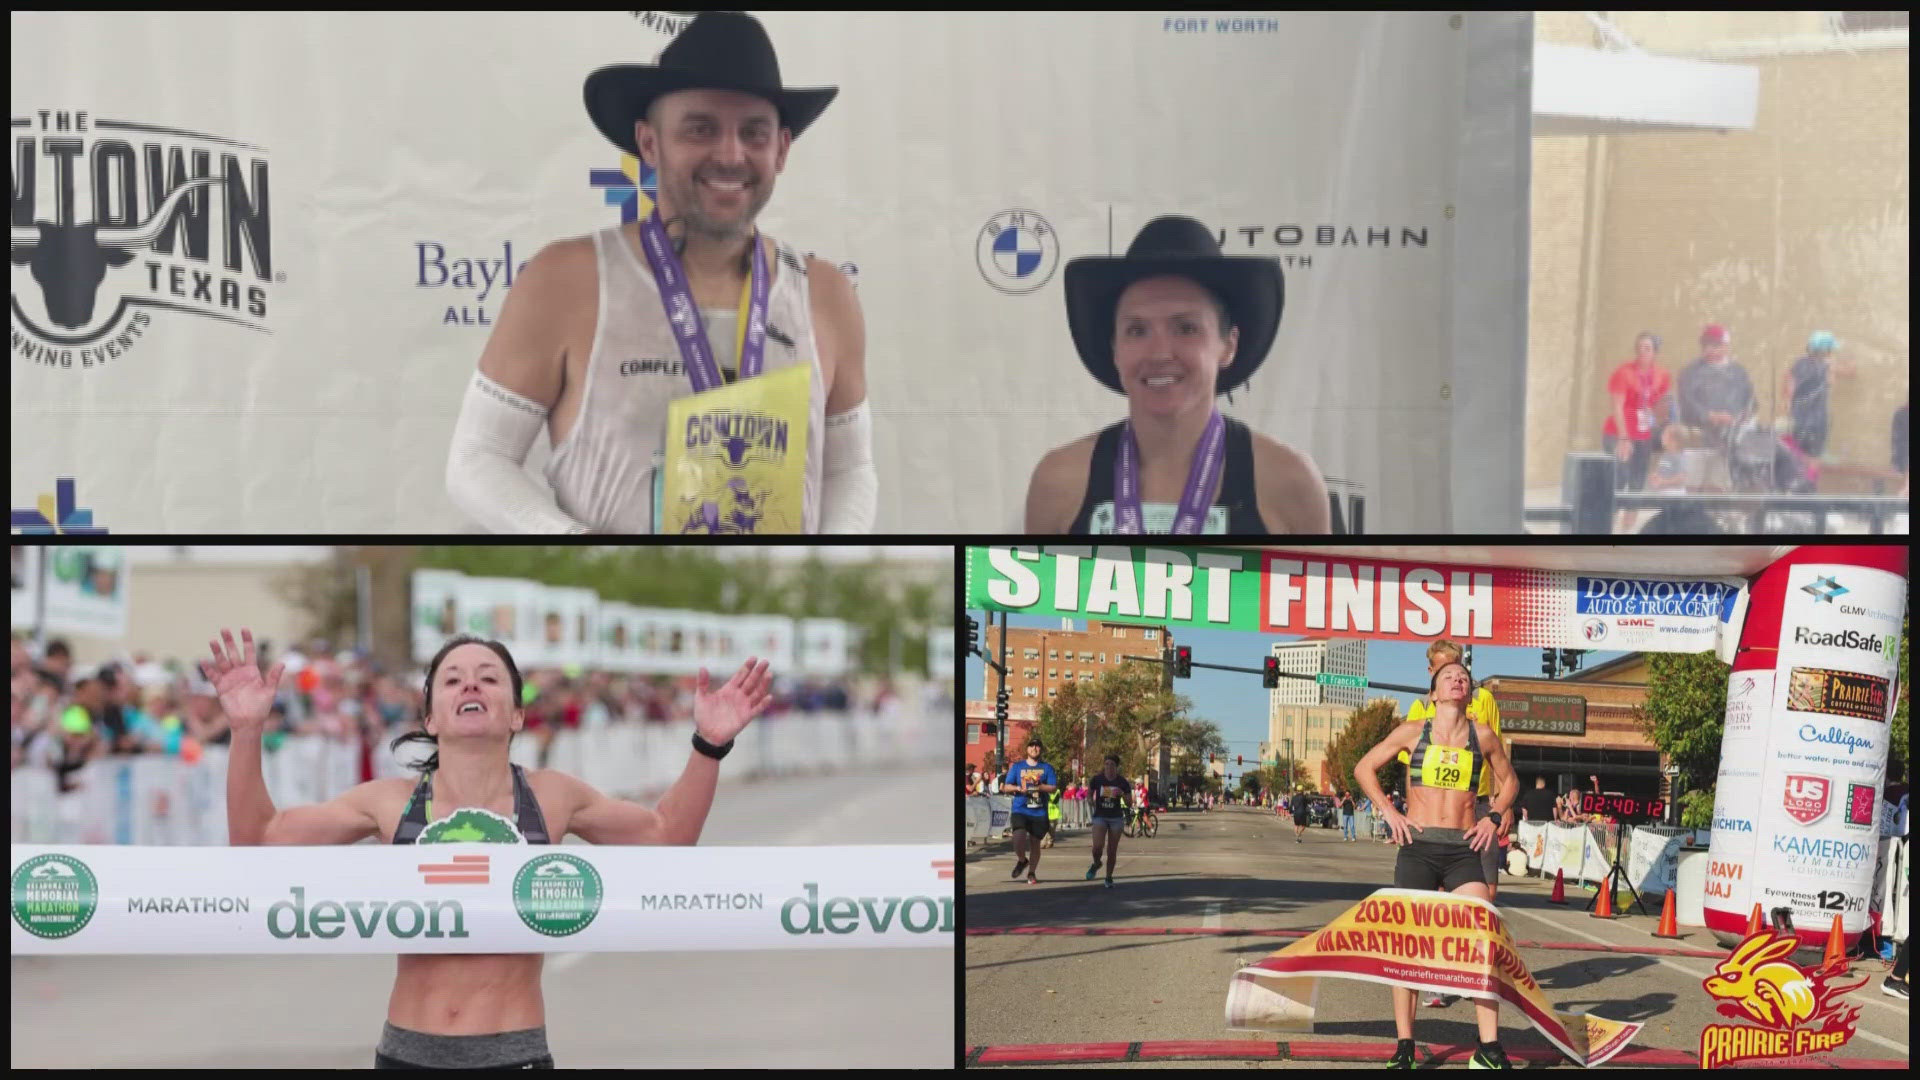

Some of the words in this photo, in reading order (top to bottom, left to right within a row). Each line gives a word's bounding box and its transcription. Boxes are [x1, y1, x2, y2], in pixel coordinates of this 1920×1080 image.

[1163, 18, 1209, 33] FORT
[1215, 18, 1279, 33] WORTH
[38, 110, 89, 132] THE
[987, 212, 1049, 239] BMW
[145, 260, 267, 318] TEXAS
[443, 306, 492, 326] ALL
[80, 311, 152, 368] EVENTS
[619, 360, 688, 377] COMPLE
[986, 546, 1244, 625] START
[1269, 558, 1494, 639] FINISH
[1584, 578, 1734, 604] DONOVAN
[1586, 598, 1623, 614] AUTO
[1625, 599, 1637, 614] &
[1640, 600, 1684, 615] TRUCK
[1840, 604, 1866, 616] GLMV
[1616, 618, 1655, 628] GMC
[1794, 625, 1882, 654] RoadSafe
[1331, 676, 1356, 686] Francis
[1532, 695, 1566, 704] BUILDING
[1831, 677, 1870, 704] PRAIRIE
[1532, 703, 1582, 721] SALE
[1500, 718, 1581, 732] 16-292-3908
[1798, 724, 1875, 755] Culligan
[1832, 757, 1850, 766] pure
[1852, 758, 1864, 767] and
[1434, 766, 1461, 783] 129
[1790, 779, 1824, 801] US
[1583, 796, 1664, 817] 02:40:12
[1788, 800, 1822, 809] LOGO
[1773, 834, 1871, 862] KAMERION
[1787, 854, 1860, 869] WIMBLEY
[1711, 861, 1744, 881] RAVI
[26, 881, 62, 890] OKLAHOMA
[64, 881, 80, 890] CITY
[531, 879, 567, 888] OKLAHOMA
[568, 879, 584, 888] CITY
[26, 890, 80, 902] MEMORIAL
[531, 888, 585, 900] MEMORIAL
[641, 892, 764, 911] MARATHON
[1764, 887, 1817, 901] Eyewitness
[1816, 889, 1846, 911] 12
[1790, 897, 1816, 908] News
[26, 902, 80, 914] MARATHON
[127, 896, 250, 914] MARATHON
[266, 886, 470, 940] devon
[1354, 899, 1406, 925] 2020
[1412, 900, 1500, 935] WOMEN
[1315, 931, 1436, 960] MARATHON
